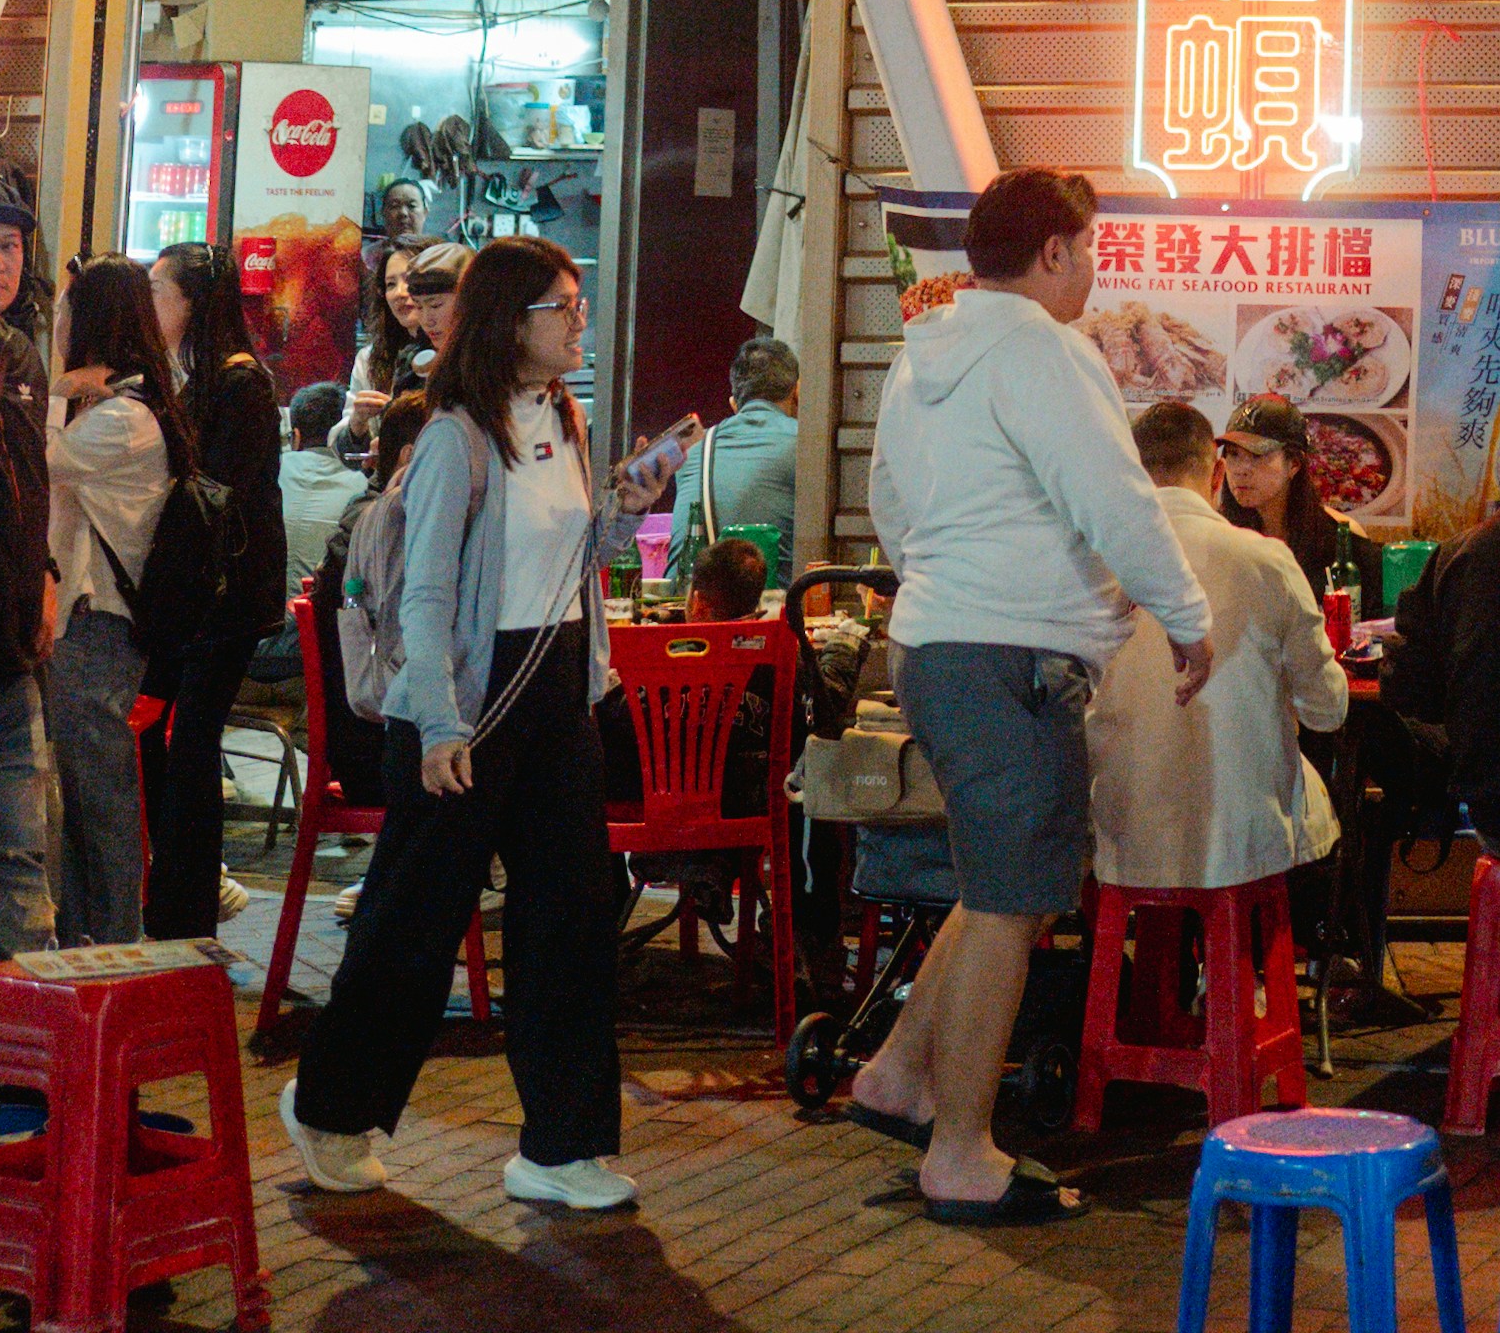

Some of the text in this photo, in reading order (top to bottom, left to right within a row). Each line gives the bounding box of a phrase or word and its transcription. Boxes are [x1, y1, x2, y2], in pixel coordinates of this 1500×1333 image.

[266, 188, 288, 196] TASTE
[1097, 221, 1374, 278] 榮發大排檔
[1098, 276, 1373, 296] WING FAT SEAFOOD RESTAURANT
